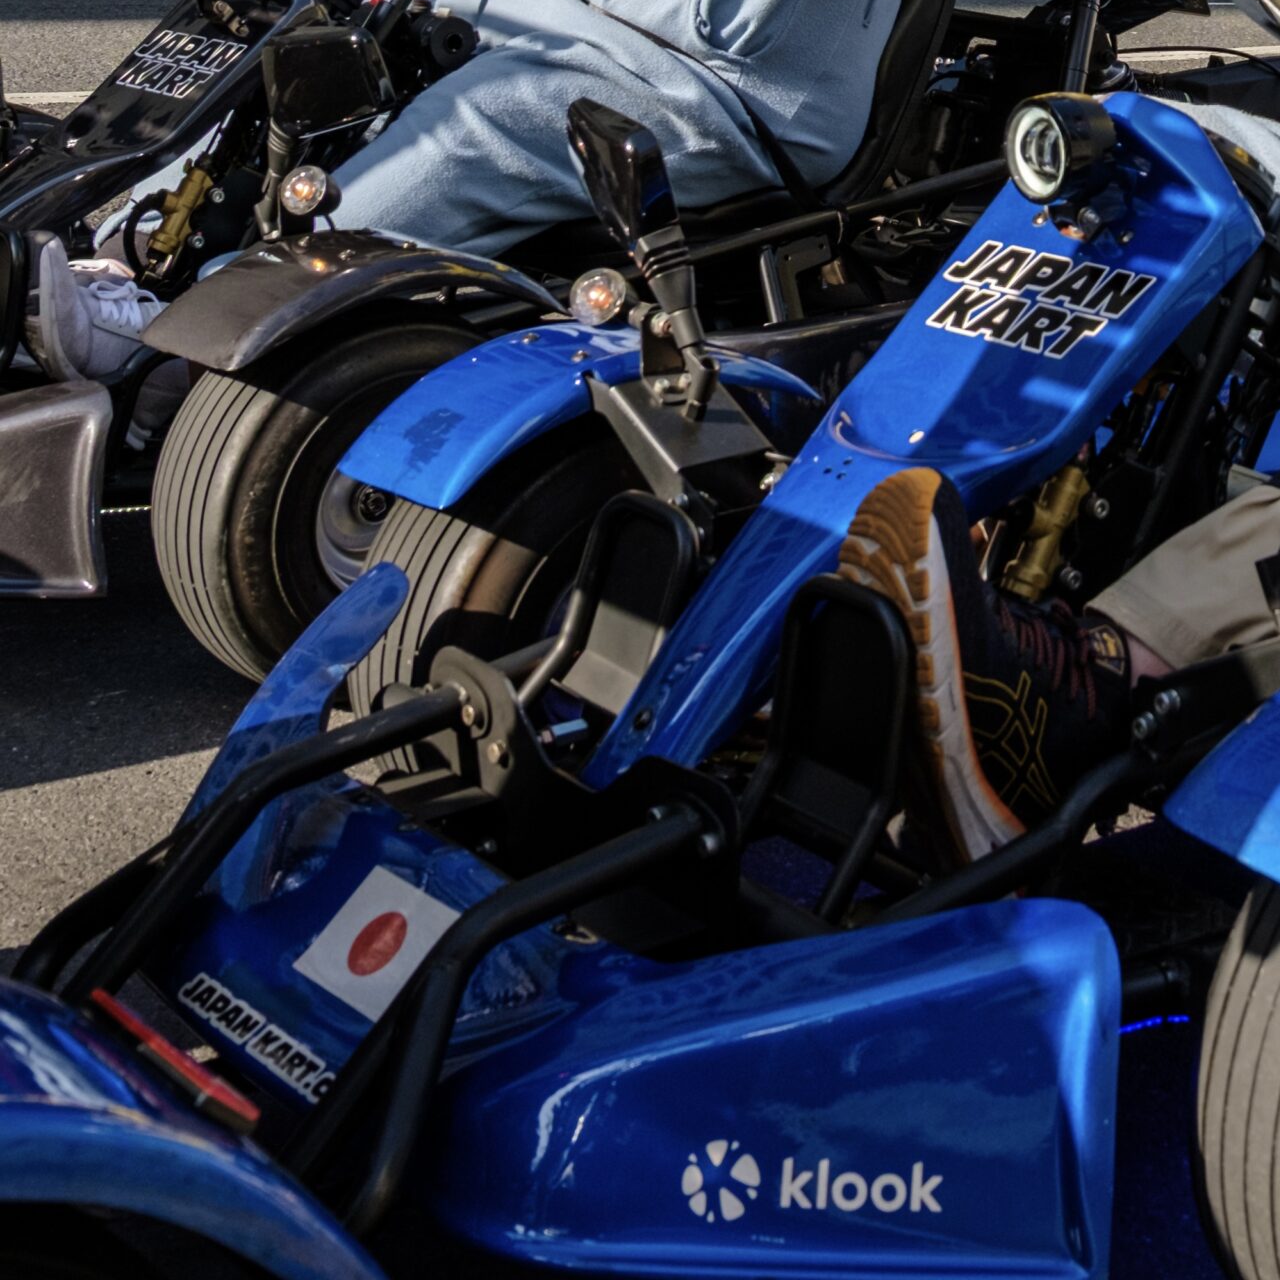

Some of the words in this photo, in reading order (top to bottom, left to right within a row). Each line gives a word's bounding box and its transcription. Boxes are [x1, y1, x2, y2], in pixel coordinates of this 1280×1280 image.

[116, 57, 215, 99] KART
[133, 29, 249, 73] JAPAN
[942, 239, 1157, 319] JAPAN
[925, 284, 1109, 359] KART
[179, 973, 265, 1044] JAPAN
[779, 1156, 944, 1213] klook
